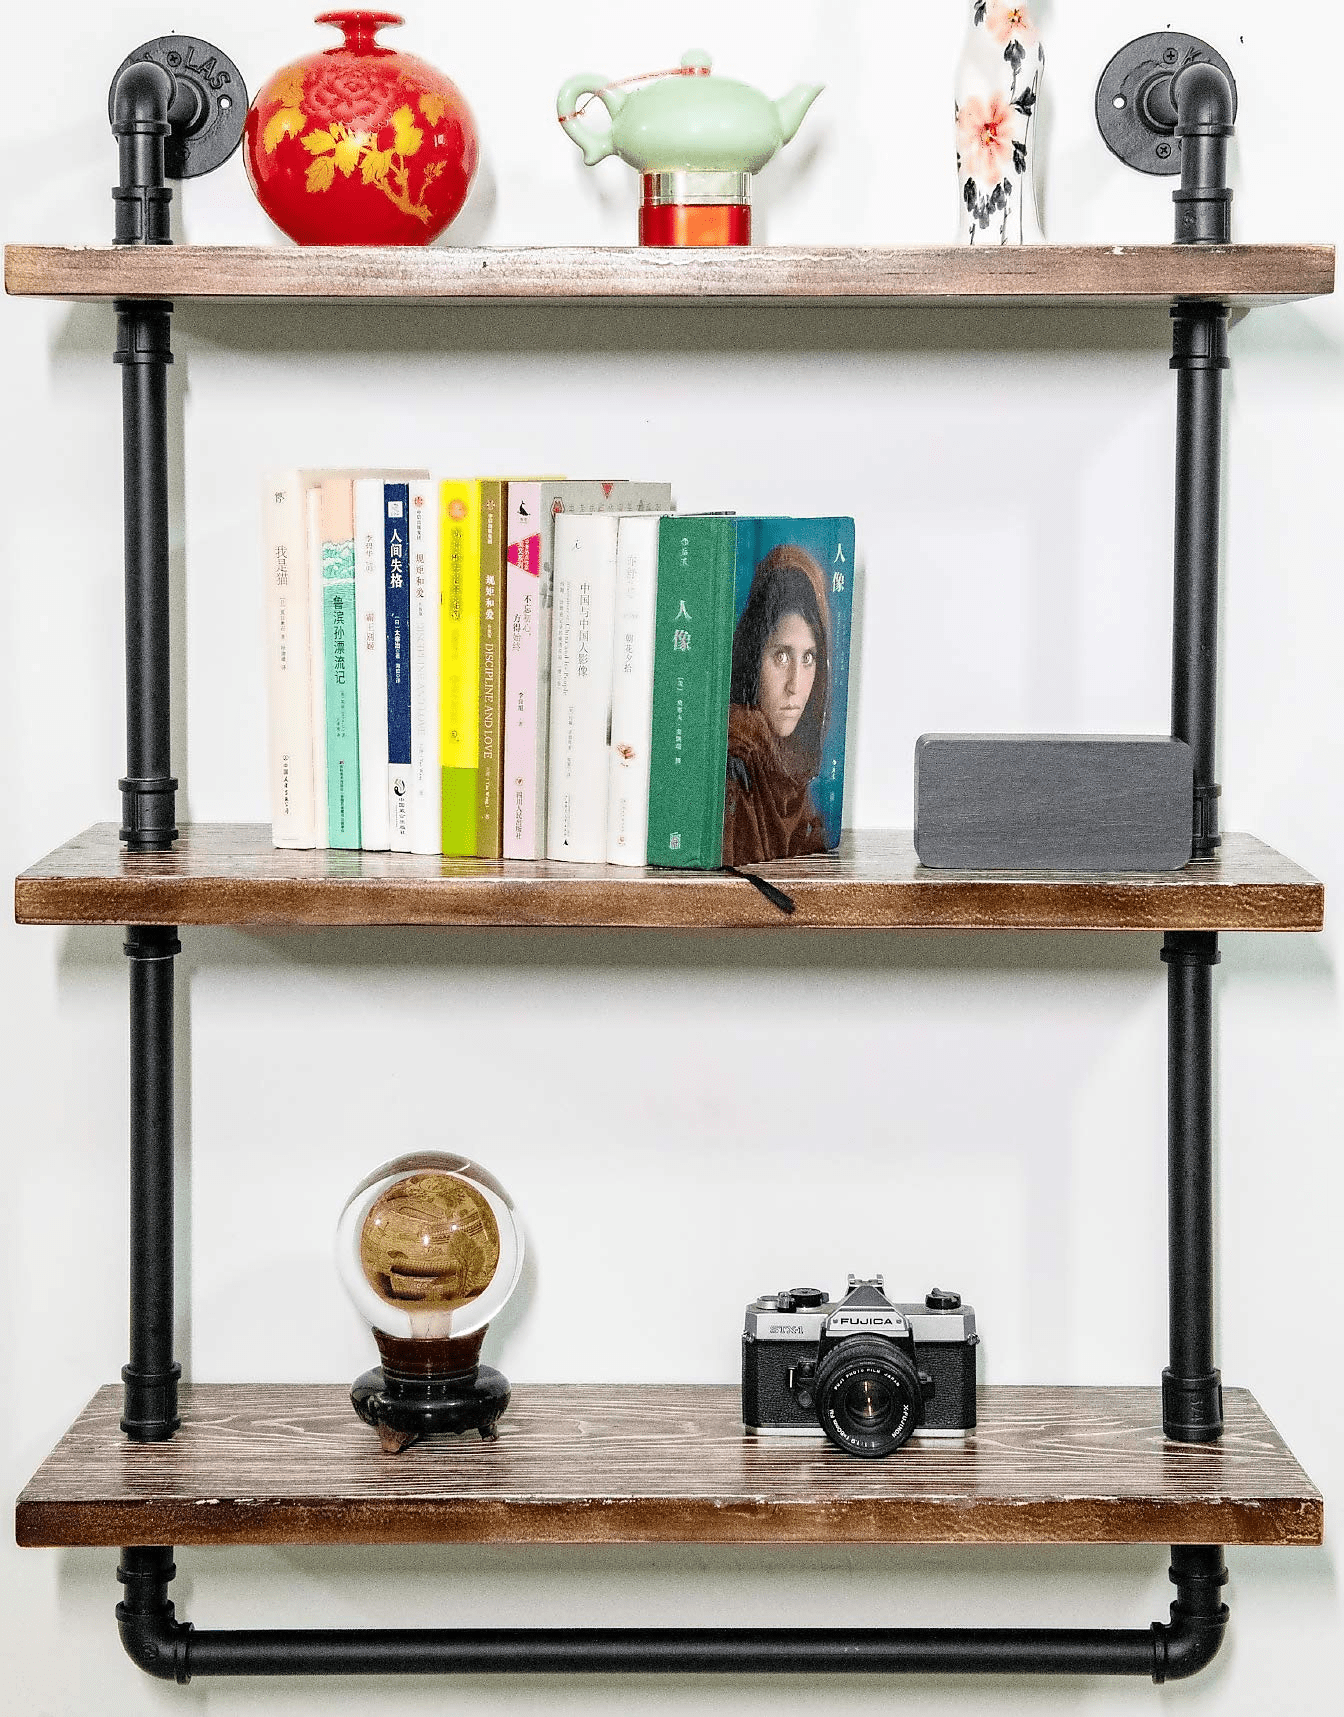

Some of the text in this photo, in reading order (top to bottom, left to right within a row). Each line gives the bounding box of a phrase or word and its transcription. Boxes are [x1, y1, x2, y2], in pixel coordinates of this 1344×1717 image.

[275, 545, 288, 585] 我是猫
[390, 528, 403, 588] 人间失格
[833, 543, 846, 593] 人像
[485, 575, 496, 620] 规矩和爱
[333, 595, 346, 684] 鲁滨孙漂流记
[579, 583, 590, 677] 中国与中国人影像
[674, 599, 692, 651] 人像
[484, 644, 494, 702] DISCIPLINE
[484, 705, 493, 728] AND
[483, 731, 493, 759] LOVE
[891, 1404, 909, 1438] X-FUJINON
